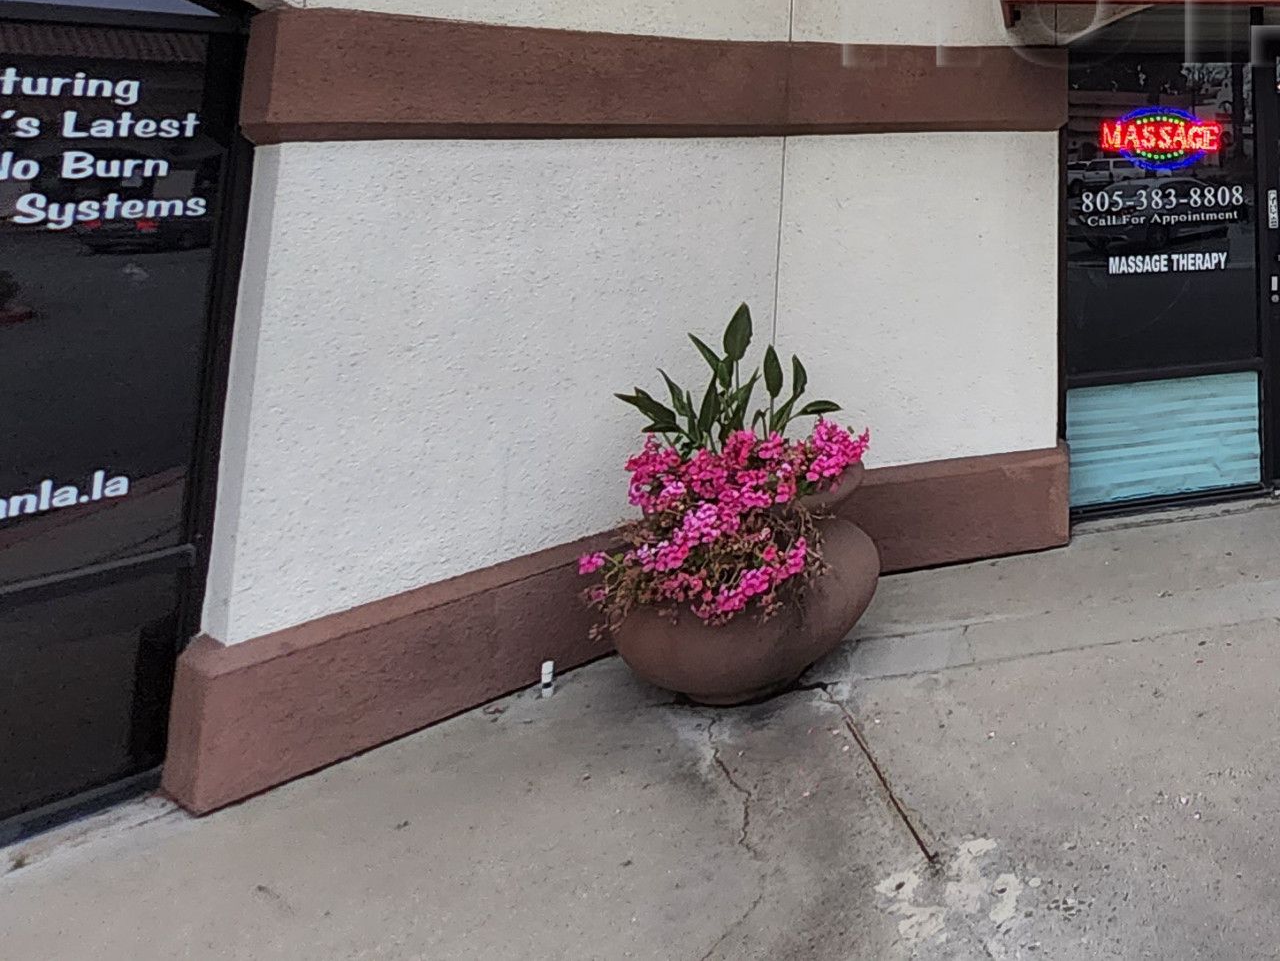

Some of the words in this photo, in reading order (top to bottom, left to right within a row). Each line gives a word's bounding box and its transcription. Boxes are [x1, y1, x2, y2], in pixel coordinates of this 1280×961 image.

[0, 67, 140, 105] turing
[62, 110, 200, 138] Latest
[1101, 121, 1221, 150] MASSAGE
[61, 151, 168, 179] Burn
[13, 193, 206, 230] Systems
[1082, 186, 1243, 212] 805-383-8808
[1088, 215, 1117, 227] Call
[1121, 214, 1146, 225] For
[1150, 211, 1238, 225] Appointment
[1109, 254, 1168, 274] MASSAGE
[1171, 252, 1227, 271] THERAPY
